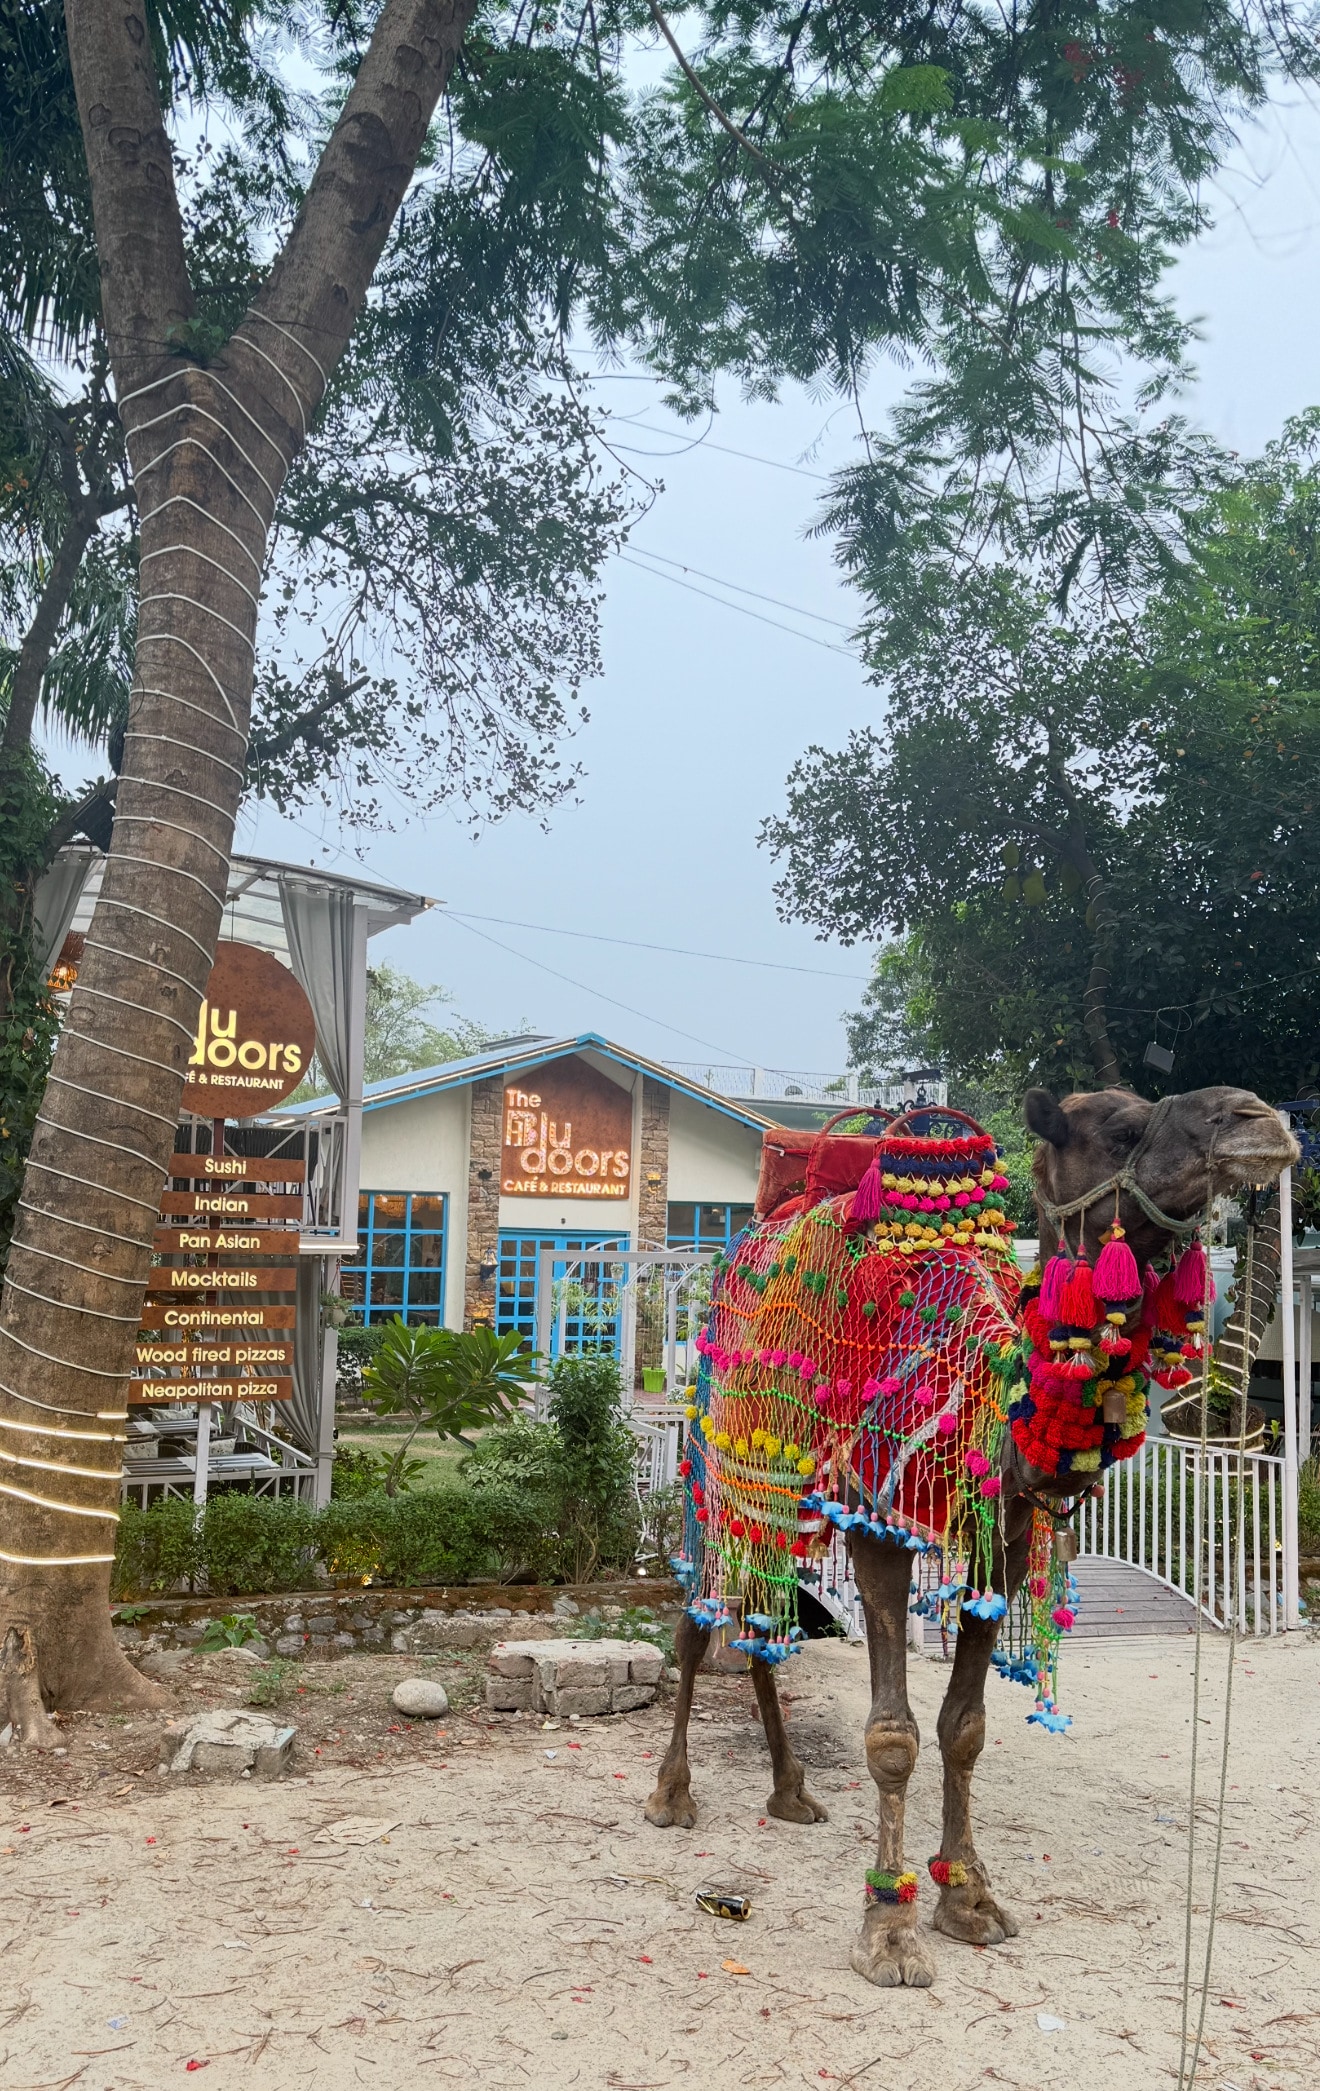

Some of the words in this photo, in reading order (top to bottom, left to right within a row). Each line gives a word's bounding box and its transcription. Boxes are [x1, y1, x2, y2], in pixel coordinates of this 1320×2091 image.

[199, 999, 237, 1039] lu
[198, 1073, 208, 1085] &
[210, 1074, 284, 1090] RESTAURANT
[506, 1089, 542, 1108] The
[505, 1110, 572, 1149] Blu
[520, 1135, 629, 1178] doors
[204, 1158, 247, 1175] Sushi
[503, 1176, 539, 1192] CAFÉ
[539, 1182, 549, 1192] &
[551, 1181, 626, 1196] RESTAURANT
[194, 1196, 249, 1213] Indian
[179, 1233, 211, 1249] Pan
[215, 1233, 261, 1249] Asian
[171, 1270, 258, 1287] Mocktails
[164, 1310, 264, 1326] Continental
[136, 1347, 187, 1363] Wood
[192, 1347, 231, 1362] fired
[235, 1345, 286, 1364] pizzas
[142, 1382, 233, 1399] Neapolitan
[237, 1381, 278, 1398] pizza
